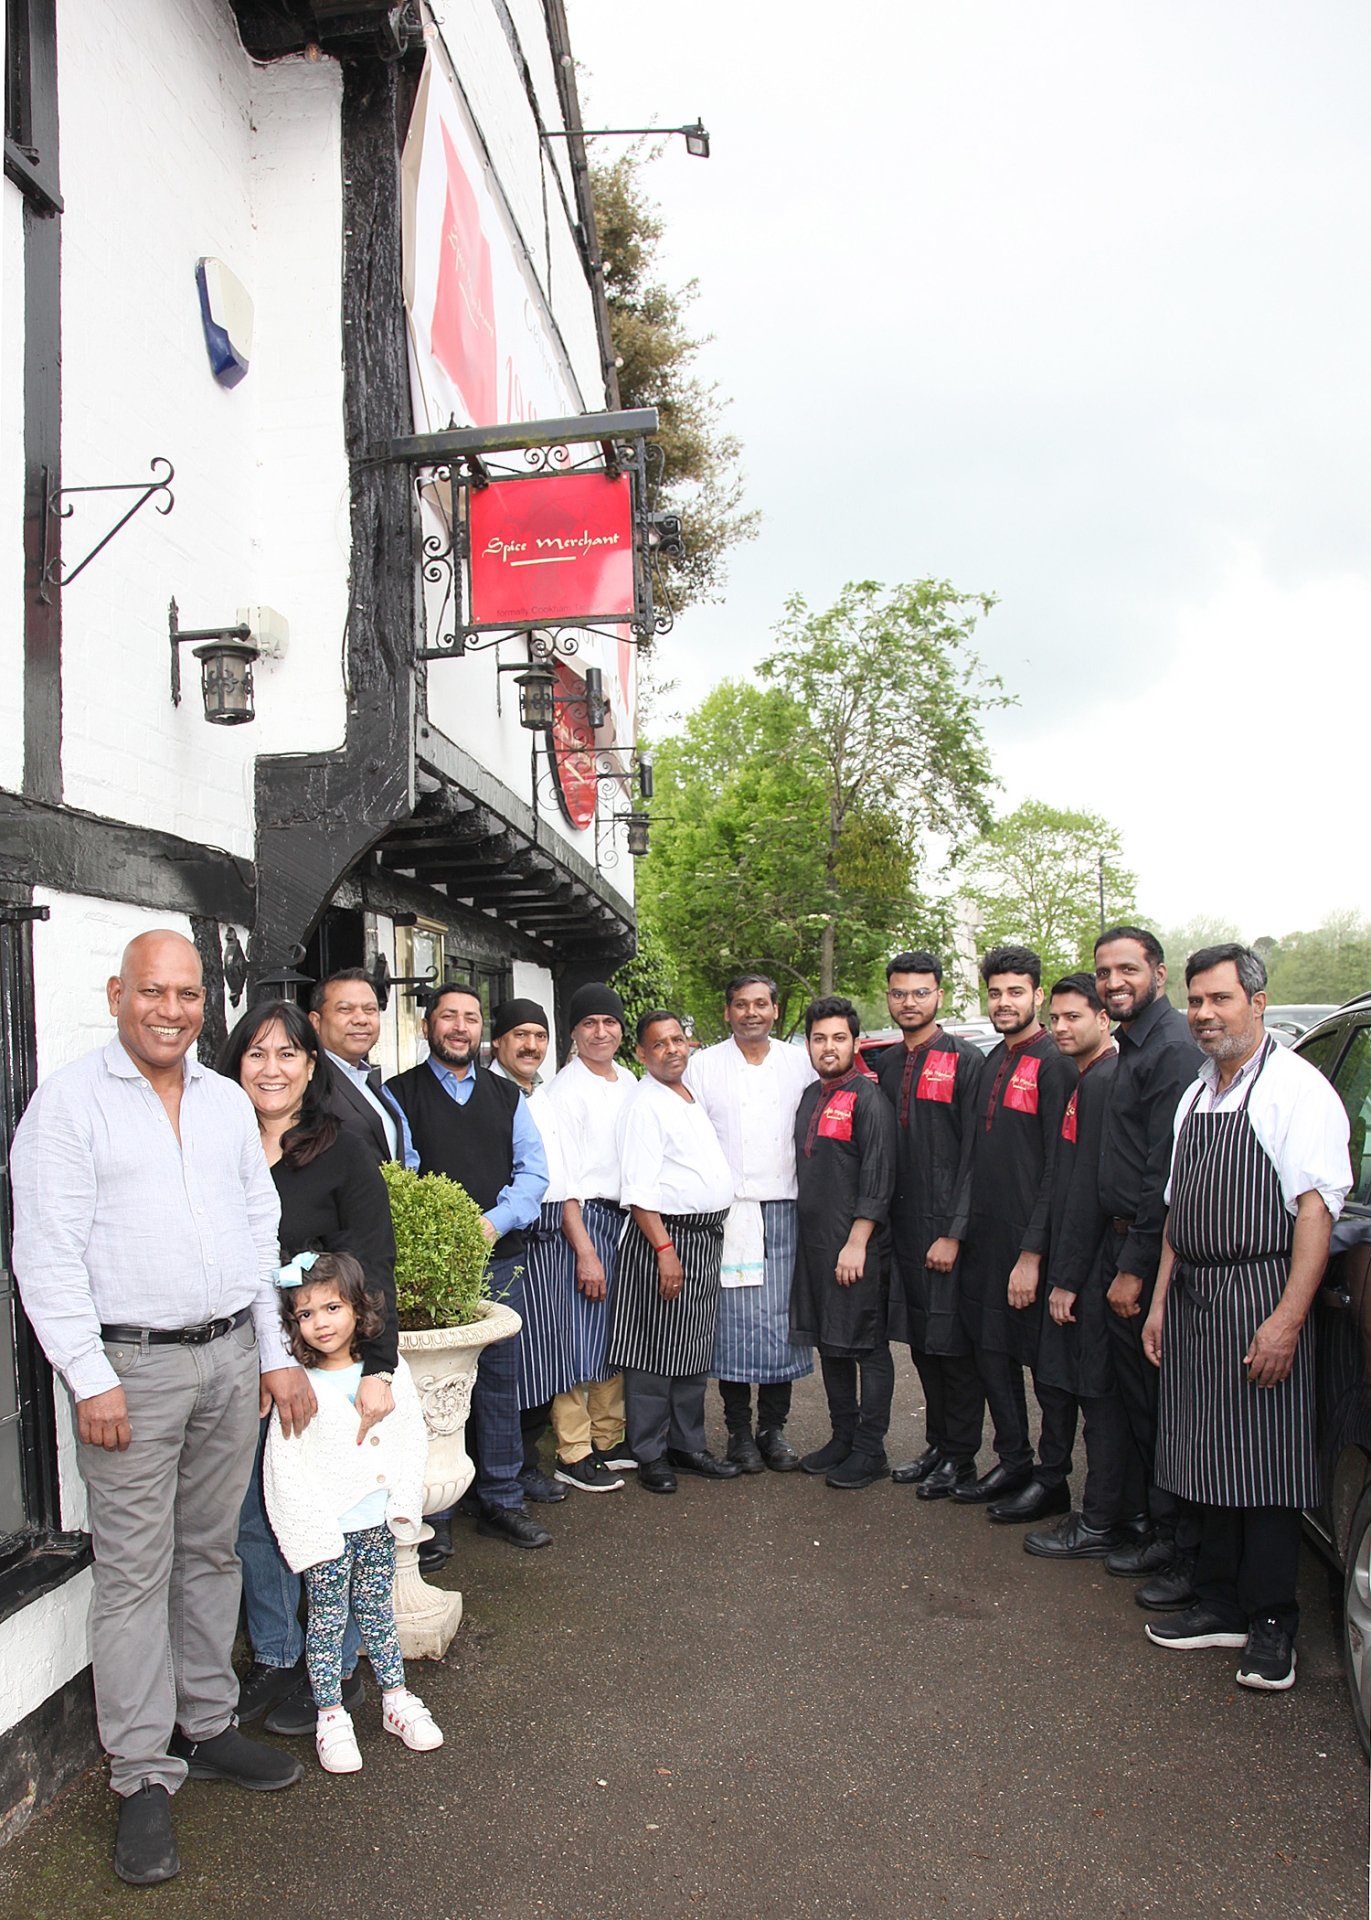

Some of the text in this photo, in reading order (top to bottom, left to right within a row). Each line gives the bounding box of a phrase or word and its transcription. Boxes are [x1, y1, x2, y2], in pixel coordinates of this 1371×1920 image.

[481, 529, 620, 562] Spice Merchant
[496, 607, 529, 617] formally
[531, 604, 571, 614] Cookham
